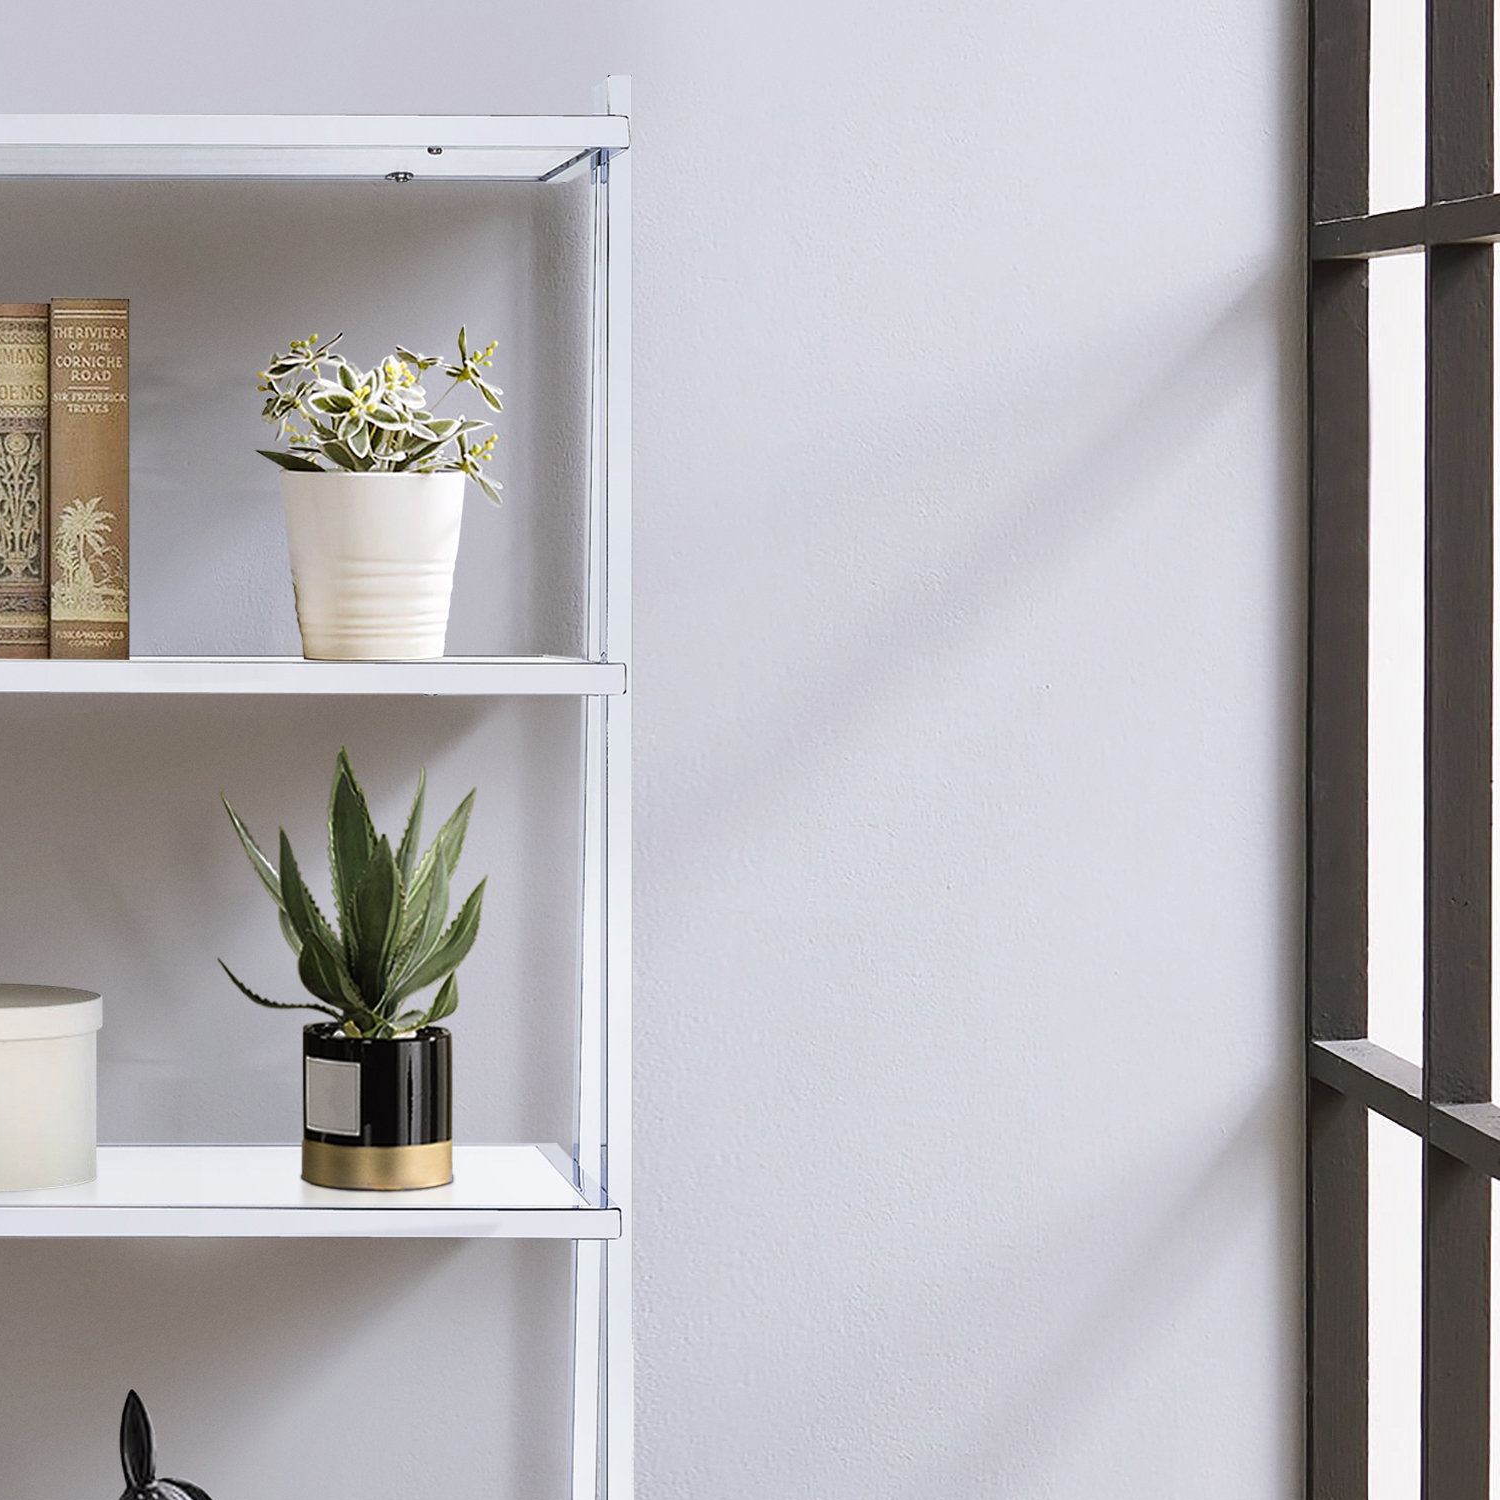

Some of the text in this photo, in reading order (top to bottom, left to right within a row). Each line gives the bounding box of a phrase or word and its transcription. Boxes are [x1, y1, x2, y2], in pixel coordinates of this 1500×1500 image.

[53, 326, 128, 340] THE RIVIERA
[68, 341, 112, 352] OF THE
[55, 355, 124, 368] CORNICHE
[71, 369, 112, 382] ROAD
